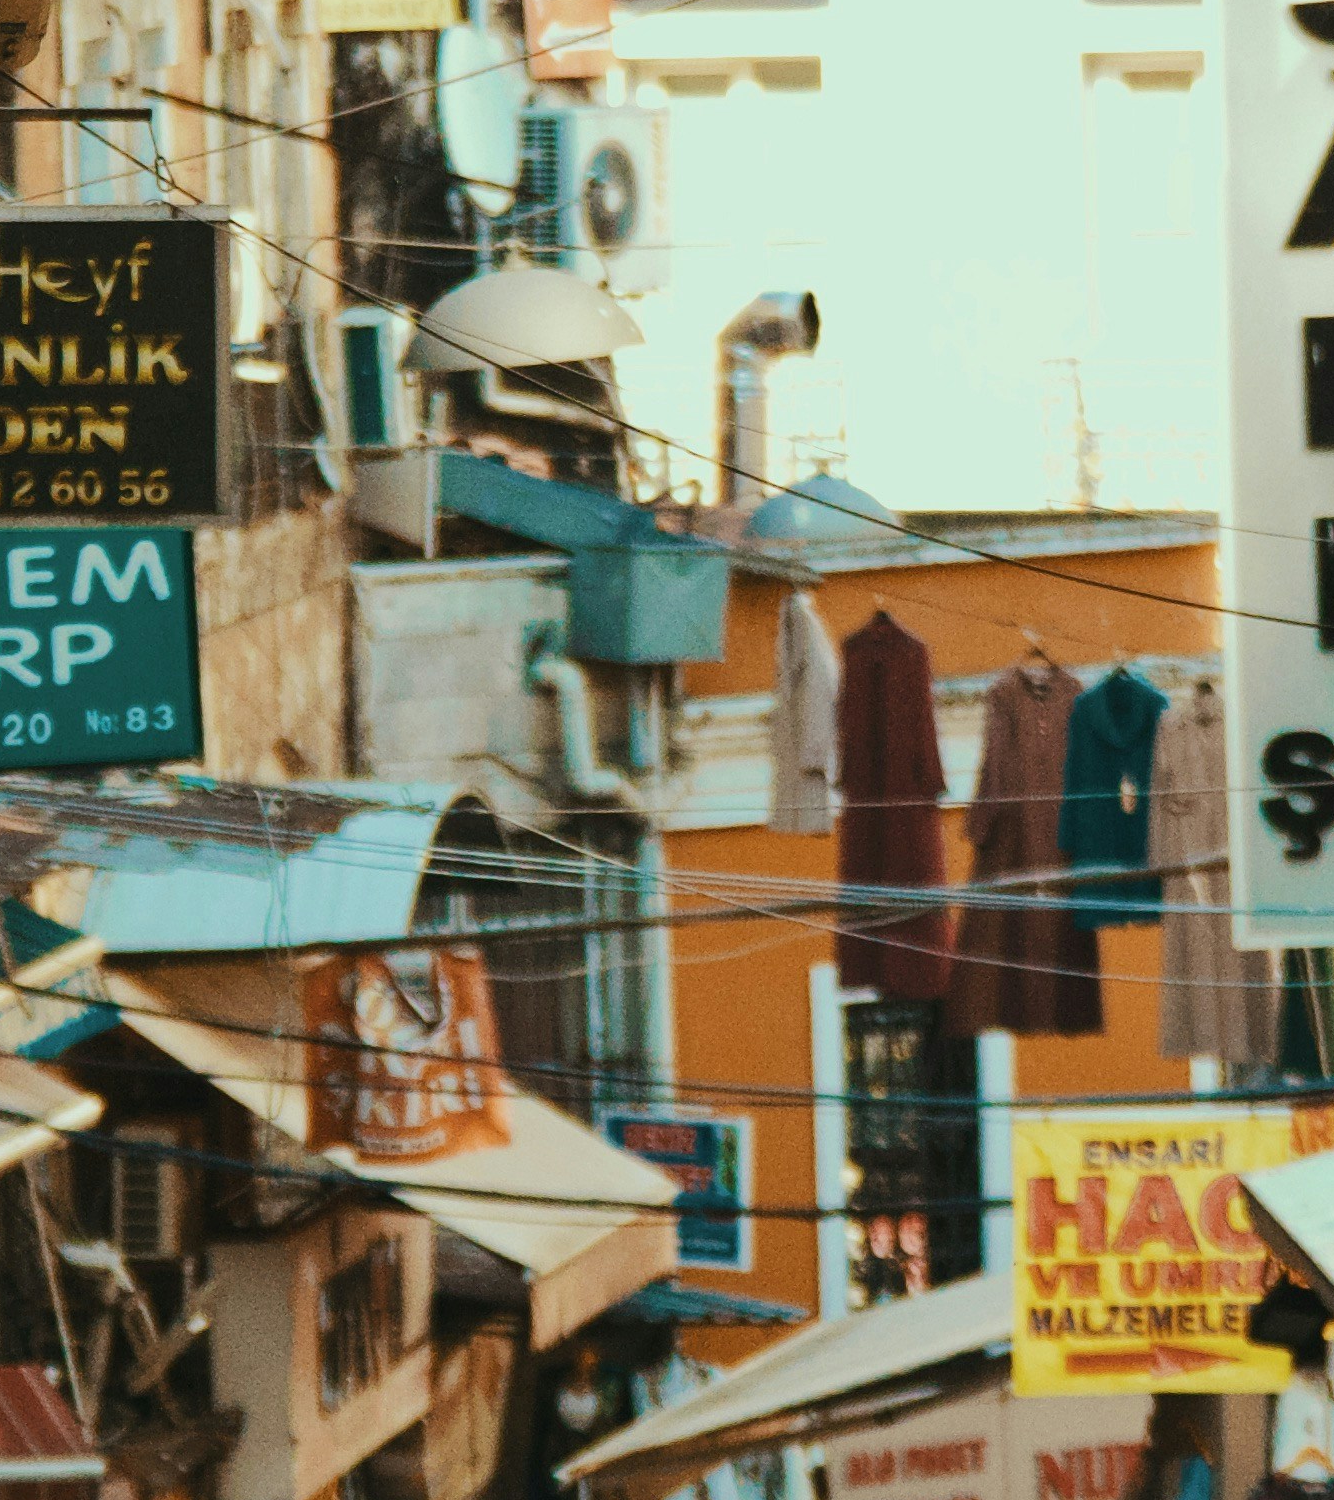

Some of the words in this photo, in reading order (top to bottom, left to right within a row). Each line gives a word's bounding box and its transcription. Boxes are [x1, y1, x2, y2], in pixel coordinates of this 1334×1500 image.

[49, 469, 102, 507] 60
[118, 467, 172, 506] 56
[2, 712, 53, 746] 20
[126, 704, 175, 732] 83
[1082, 1131, 1226, 1171] ENSARİ
